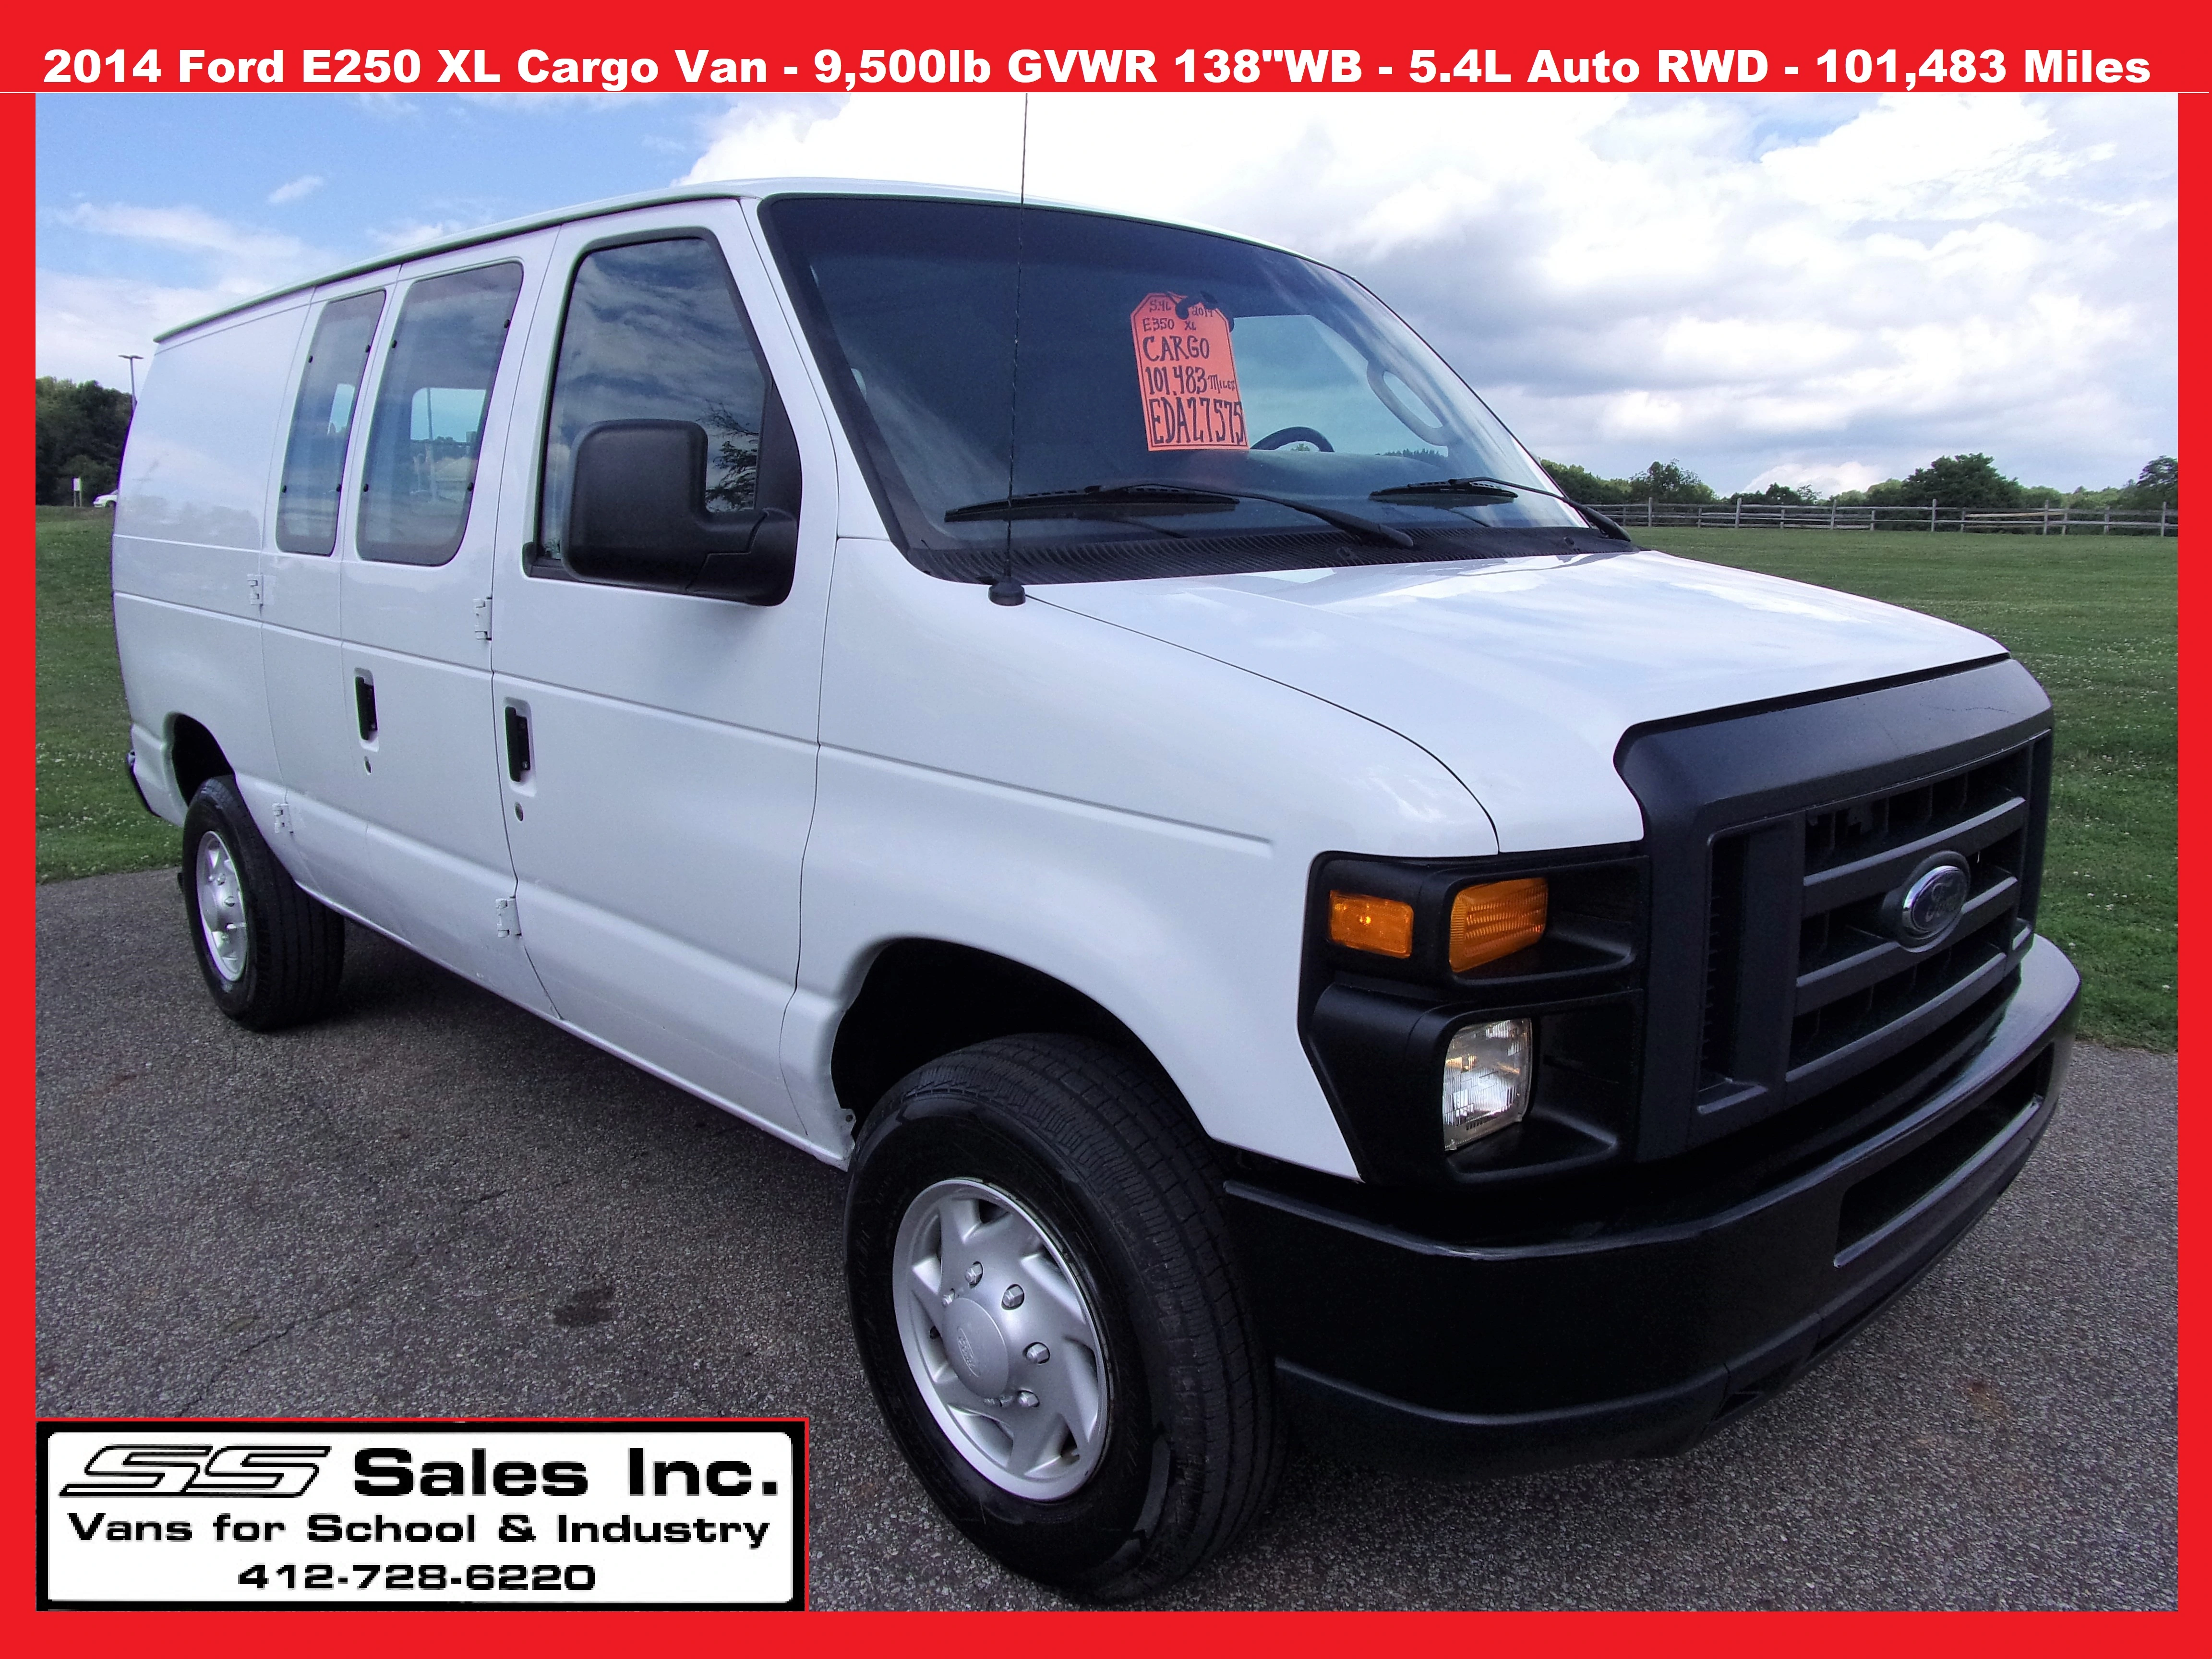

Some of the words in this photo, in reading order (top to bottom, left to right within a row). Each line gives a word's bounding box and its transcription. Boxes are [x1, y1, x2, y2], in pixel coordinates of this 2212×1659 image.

[1142, 317, 1175, 332] E350
[1185, 321, 1197, 331] XL
[1142, 336, 1210, 361] CARGO
[1149, 397, 1244, 445] EDA27575
